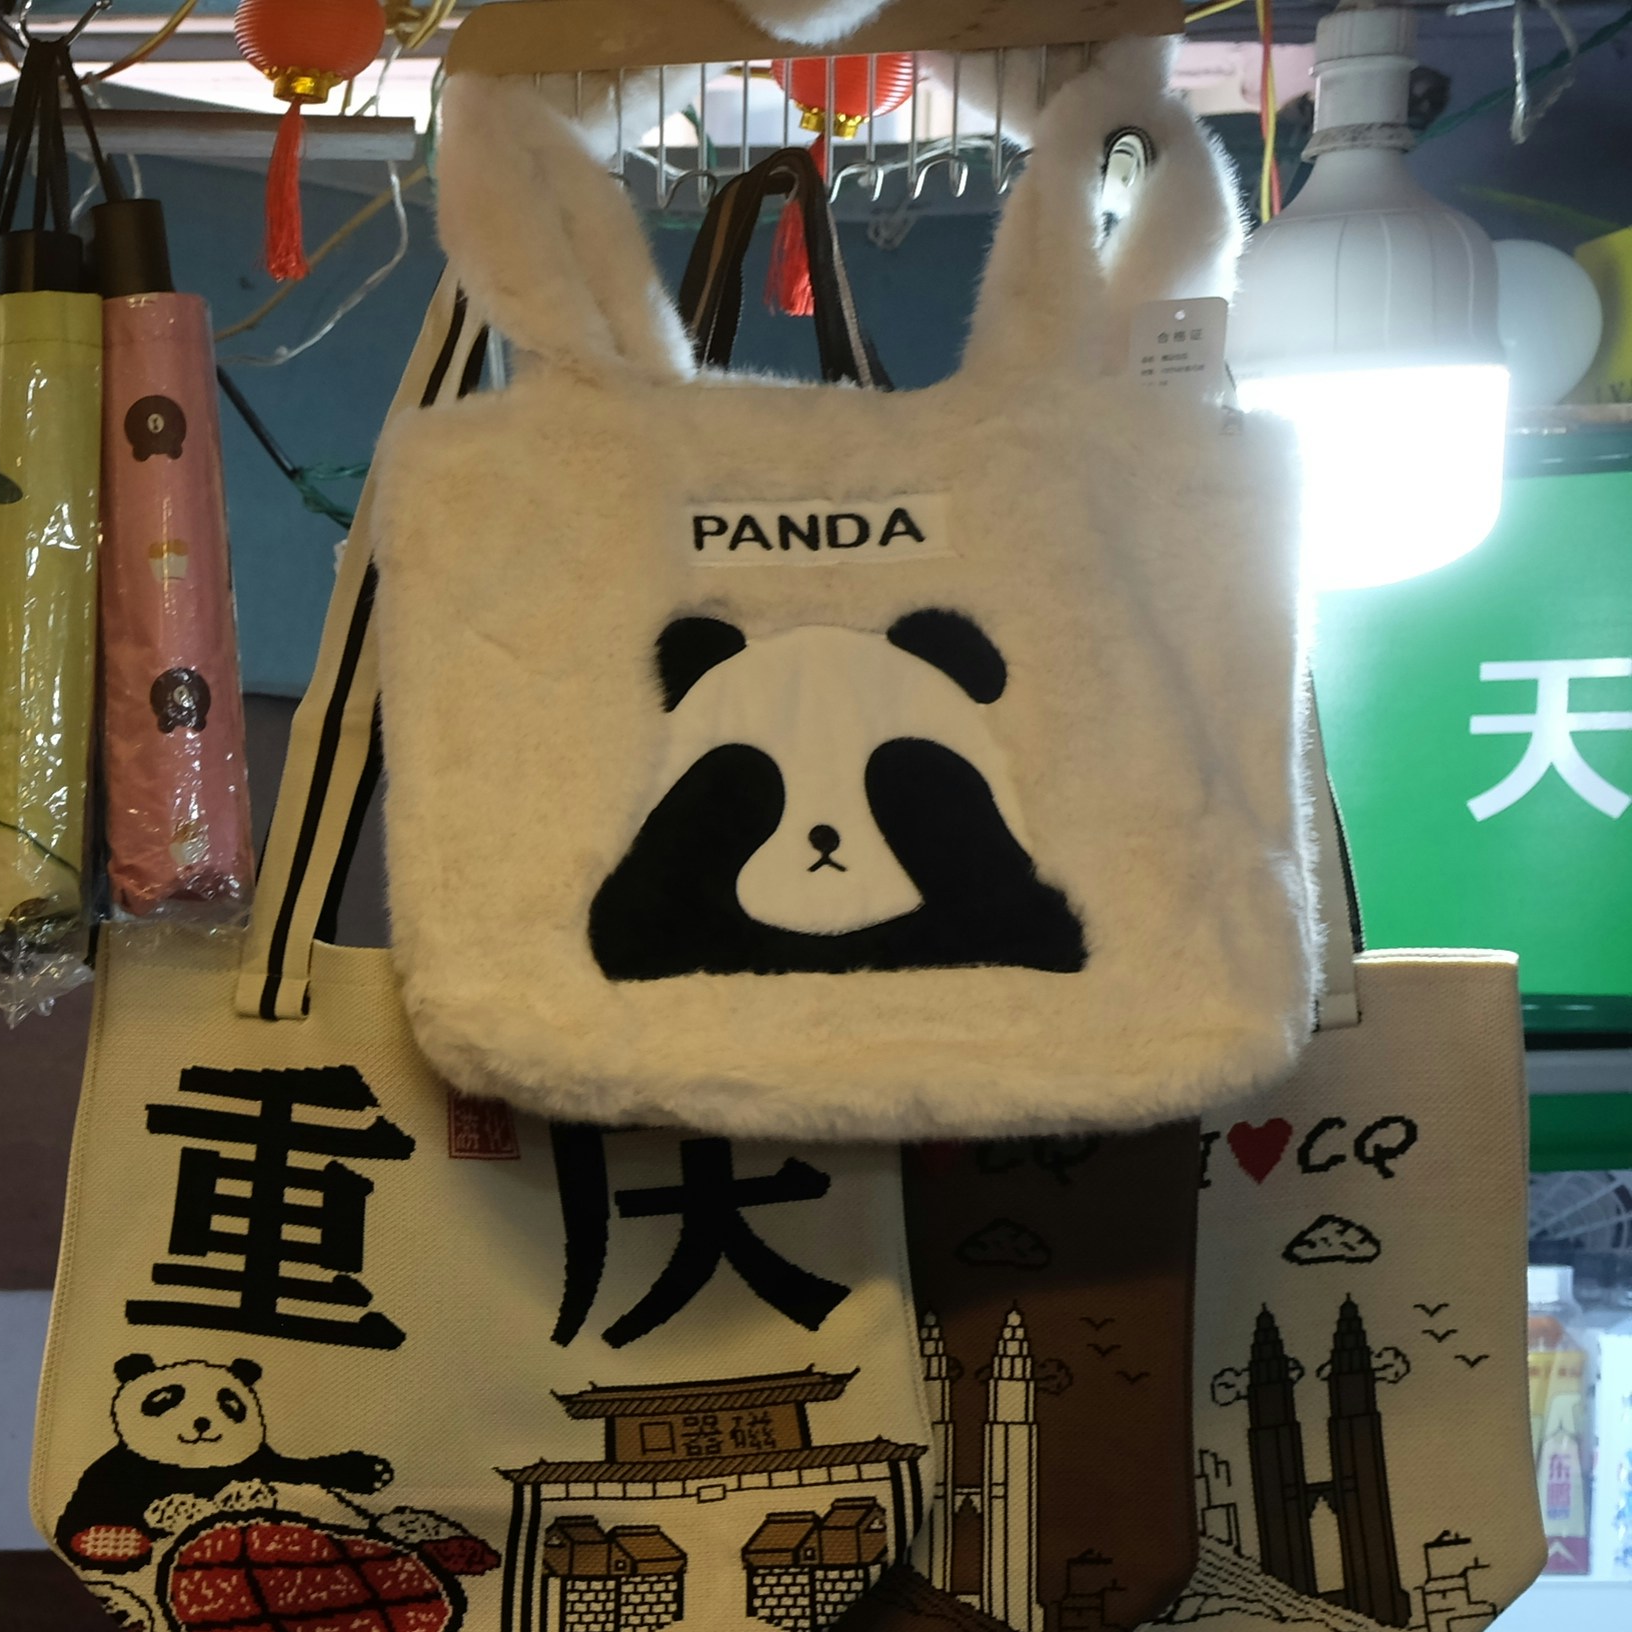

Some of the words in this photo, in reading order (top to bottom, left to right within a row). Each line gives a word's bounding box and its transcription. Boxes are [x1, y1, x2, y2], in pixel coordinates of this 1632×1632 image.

[691, 508, 926, 553] PANDA
[1466, 657, 1632, 823] 天
[1297, 1115, 1418, 1178] CQ
[124, 1063, 853, 1352] 重庆
